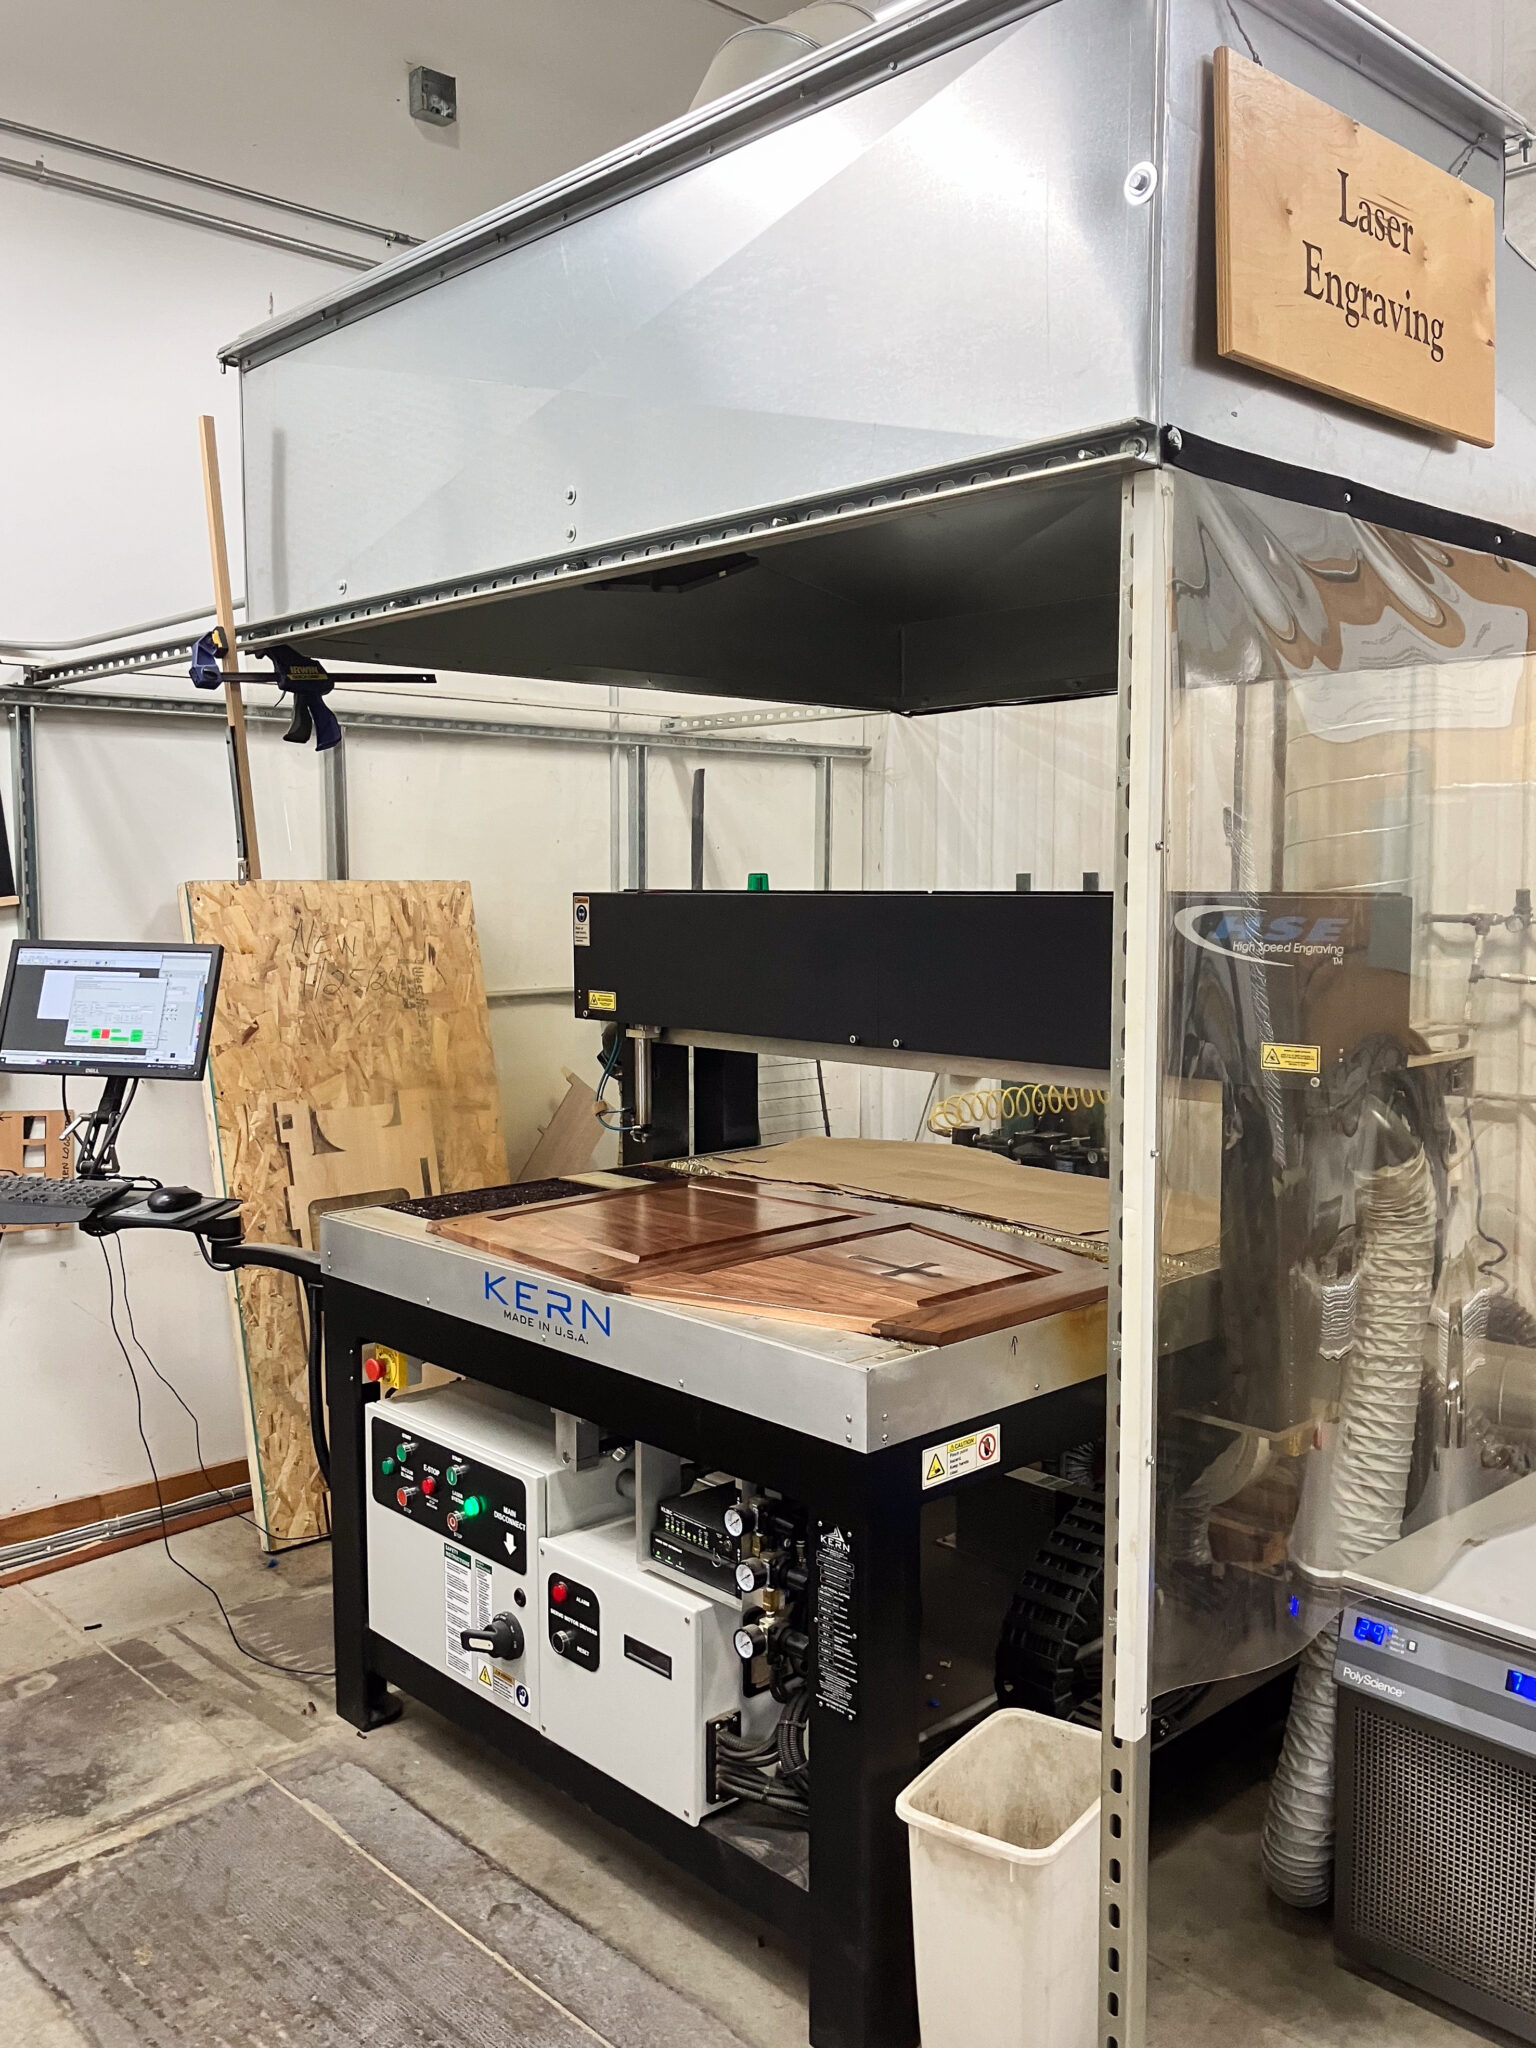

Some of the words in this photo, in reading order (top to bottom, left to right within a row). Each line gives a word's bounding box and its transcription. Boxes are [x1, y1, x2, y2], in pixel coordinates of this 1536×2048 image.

[1337, 168, 1413, 255] Laser
[1302, 240, 1445, 363] Engraving
[290, 665, 319, 674] IRWIN
[1213, 915, 1350, 943] HSE
[1232, 941, 1256, 953] High
[1259, 942, 1292, 955] Speed
[1293, 943, 1345, 956] Engraving
[484, 1271, 611, 1337] KERN
[503, 1309, 534, 1328] MADE
[538, 1320, 551, 1333] IN
[554, 1328, 590, 1345] U.S.A.
[954, 1438, 975, 1449] CAUTION
[423, 1463, 441, 1477] E-STOP
[493, 1510, 526, 1531] DISCONNECT
[503, 1506, 517, 1518] MAIN
[820, 1534, 851, 1554] KERN
[576, 1596, 590, 1607] ALARM
[1357, 1619, 1384, 1642] 29
[576, 1645, 590, 1657] RESET
[1343, 1666, 1403, 1697] PolyScience
